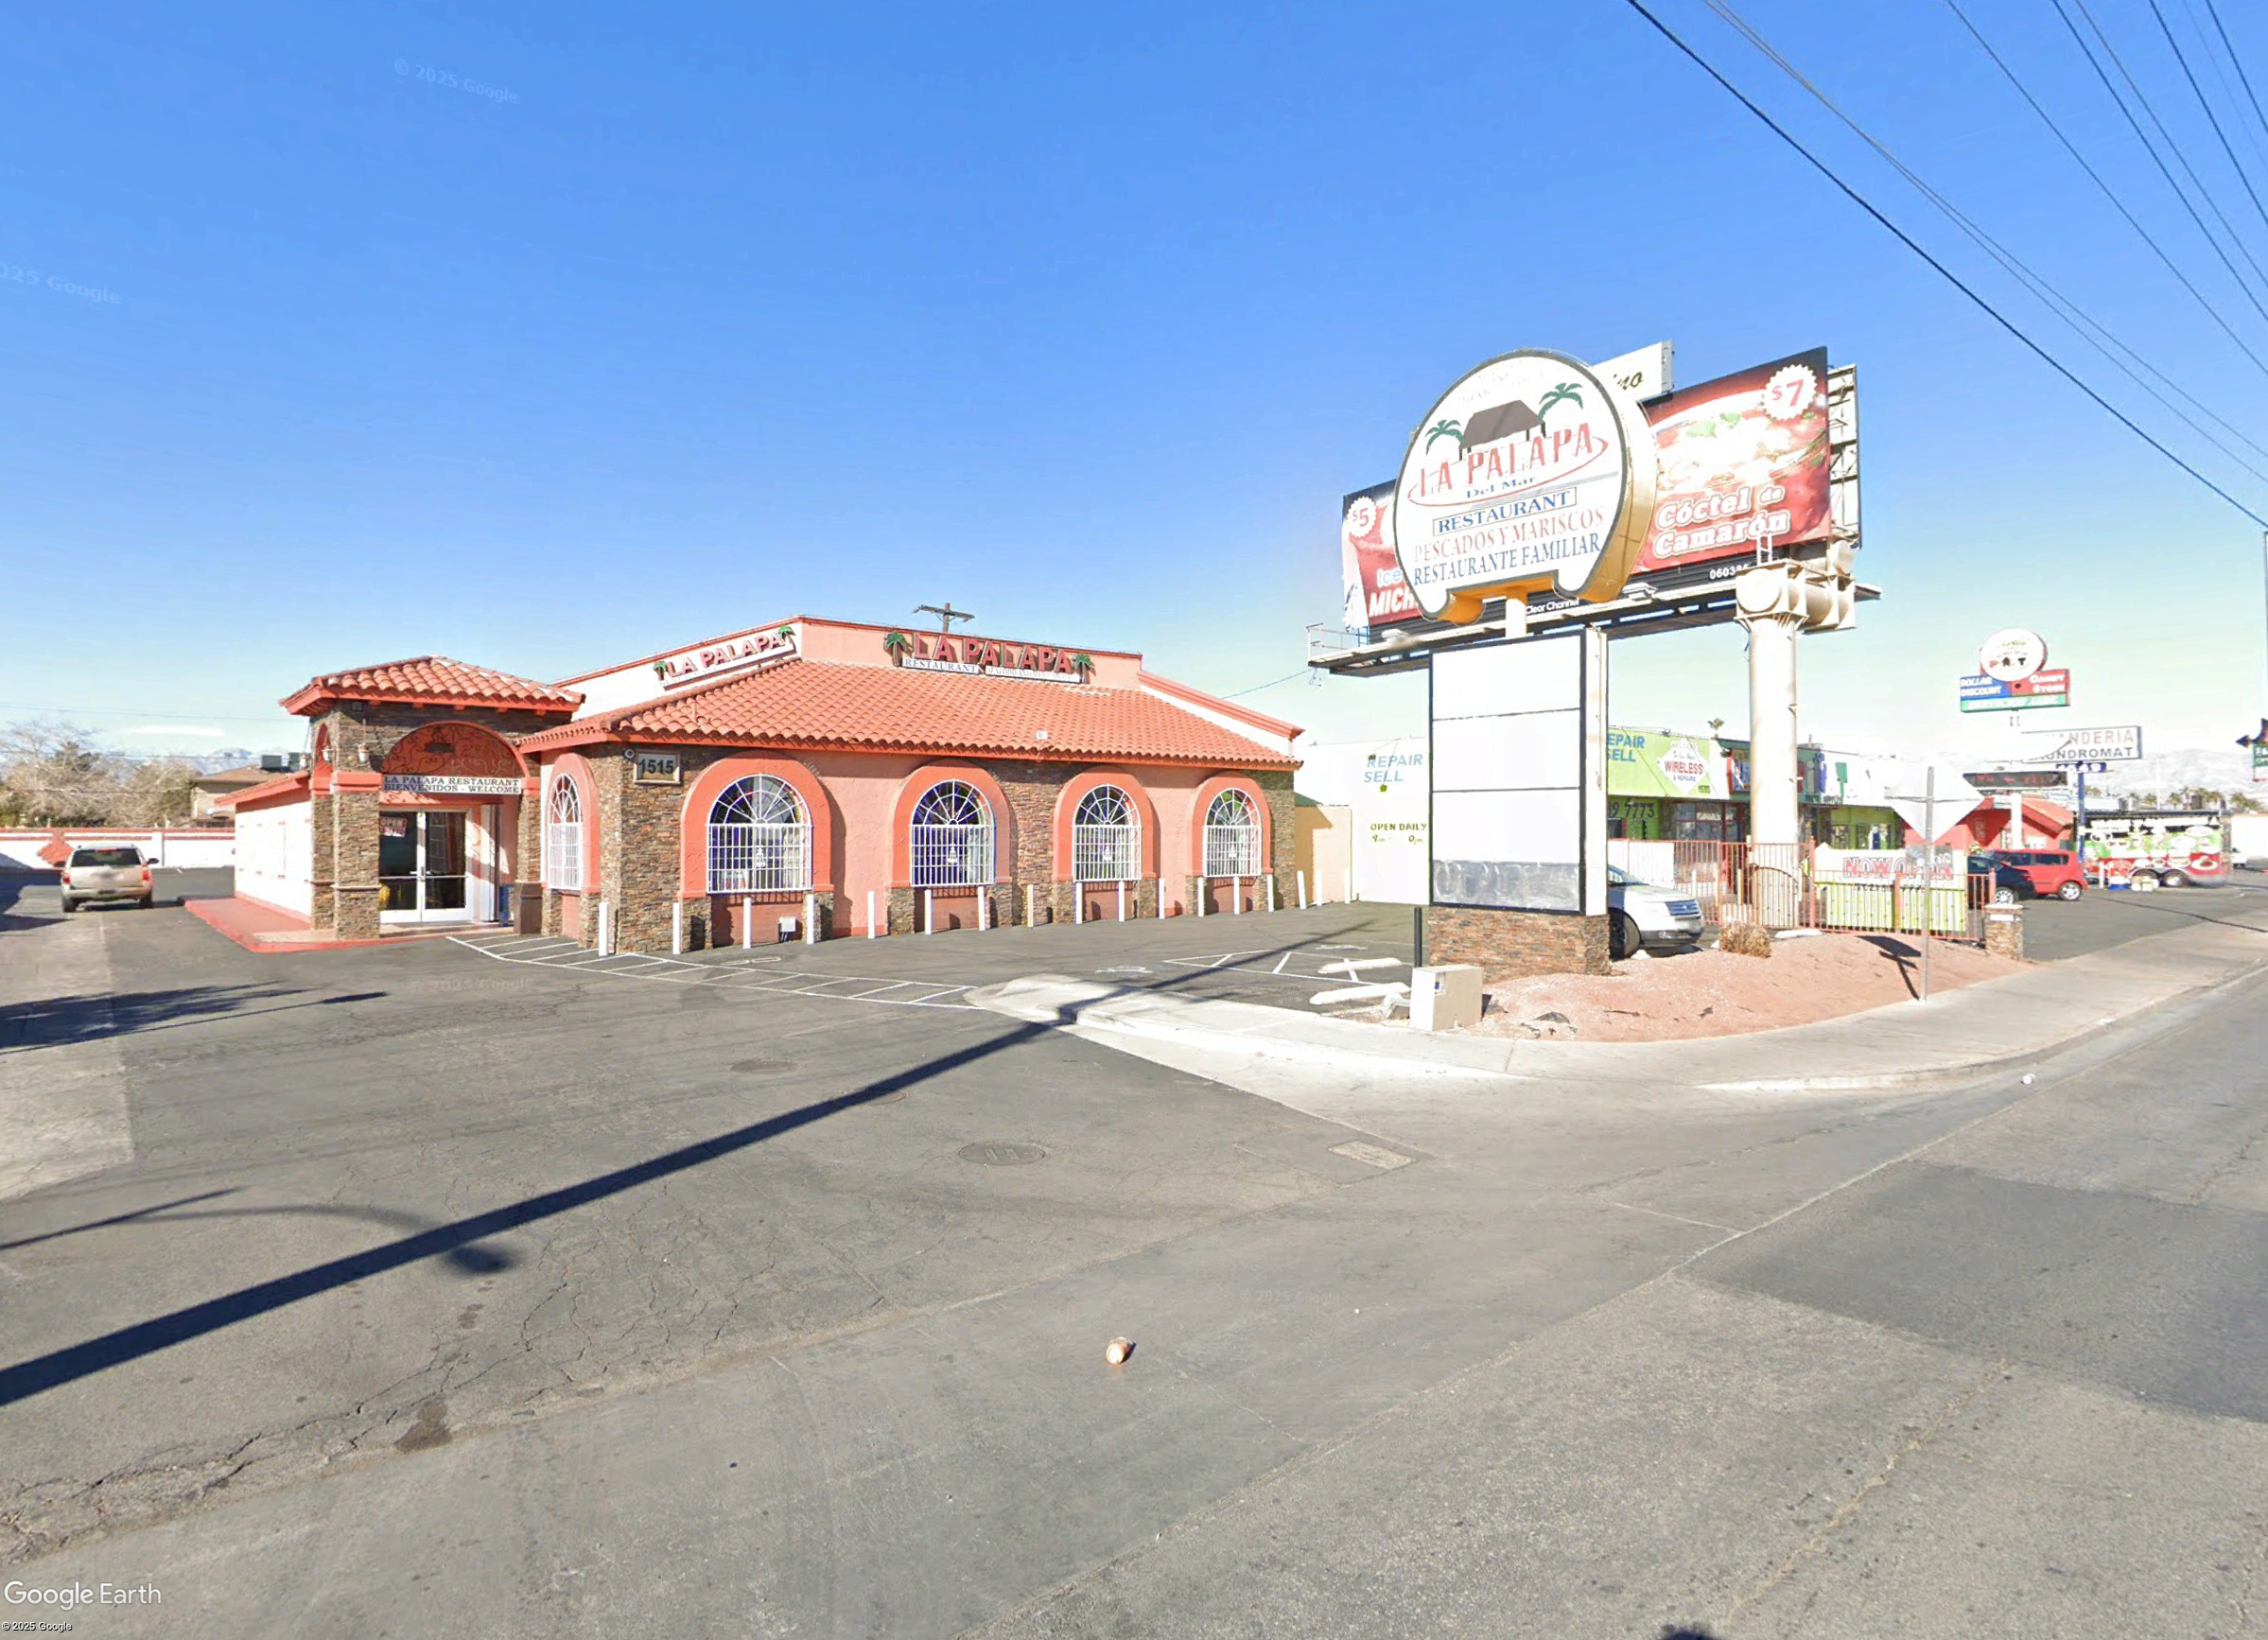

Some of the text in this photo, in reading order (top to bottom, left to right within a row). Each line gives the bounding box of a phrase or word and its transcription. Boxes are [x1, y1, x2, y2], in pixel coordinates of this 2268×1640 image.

[1772, 378, 1806, 408] $7
[1420, 422, 1594, 497] LA PALAPA
[1466, 476, 1536, 499] Del Mar
[1438, 490, 1572, 534] RESTAURANT
[1656, 484, 1786, 529] Cóctel de
[1352, 507, 1370, 529] $5
[1414, 507, 1605, 563] PESCADOS Y MARISCOS
[1413, 532, 1601, 586] RESTAURANTE FAMILIAR
[1369, 587, 1418, 618] MICH
[1526, 602, 1546, 616] Clear
[668, 656, 698, 678] LA
[700, 631, 785, 669] PALAPA
[912, 632, 1073, 674] LA PALAPA
[904, 658, 977, 673] RESTAURANT
[1606, 733, 1646, 749] EPAIR
[1367, 753, 1424, 768] REPAIR
[2040, 746, 2134, 760] UNDROMAT
[638, 759, 674, 775] 1515
[1363, 770, 1404, 783] SELL
[1665, 759, 1704, 776] WIRELESS
[383, 775, 519, 787] LA PALAPA RESTAURANT
[383, 783, 459, 793] BIENVENIDOS
[468, 785, 520, 794] WELCOME
[1370, 823, 1427, 831] OPEN DAILY
[1842, 856, 1893, 879] NOW
